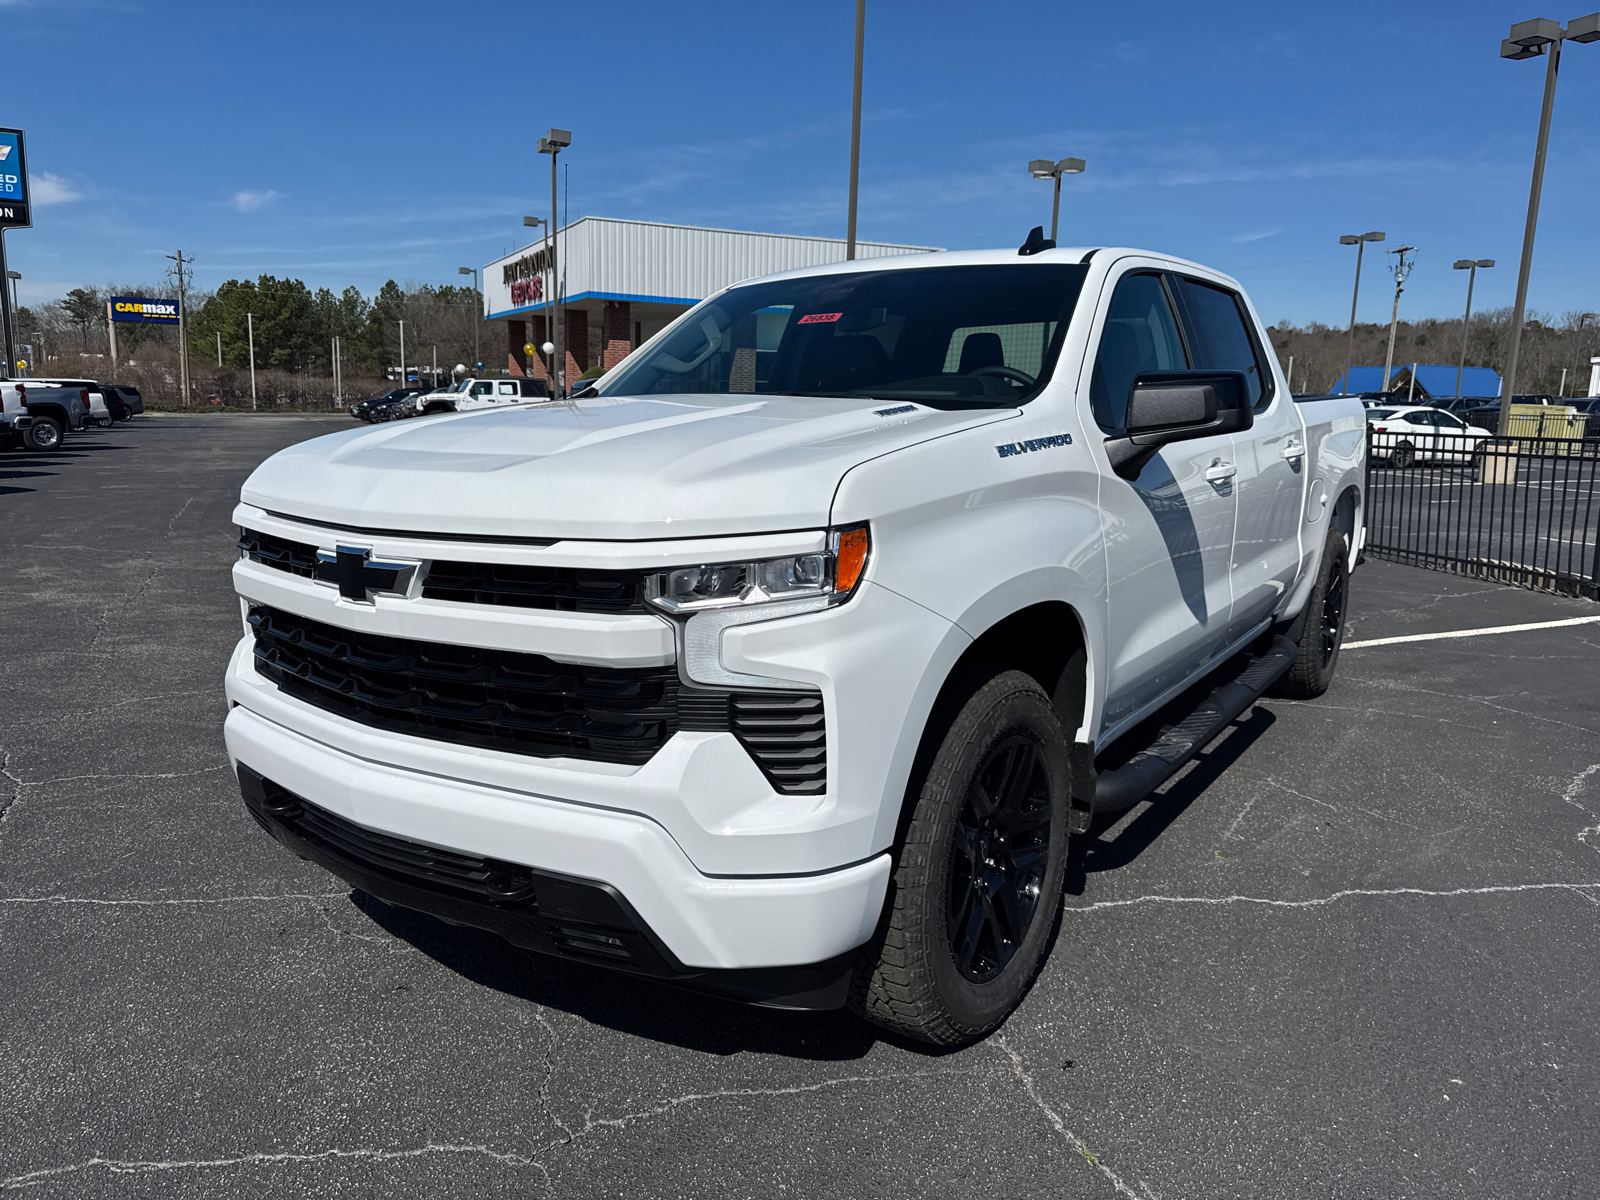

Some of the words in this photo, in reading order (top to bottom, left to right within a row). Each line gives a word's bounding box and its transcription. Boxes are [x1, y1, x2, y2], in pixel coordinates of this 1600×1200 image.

[511, 282, 525, 304] USED
[525, 276, 542, 301] CARS
[995, 433, 1072, 458] SILVERADO
